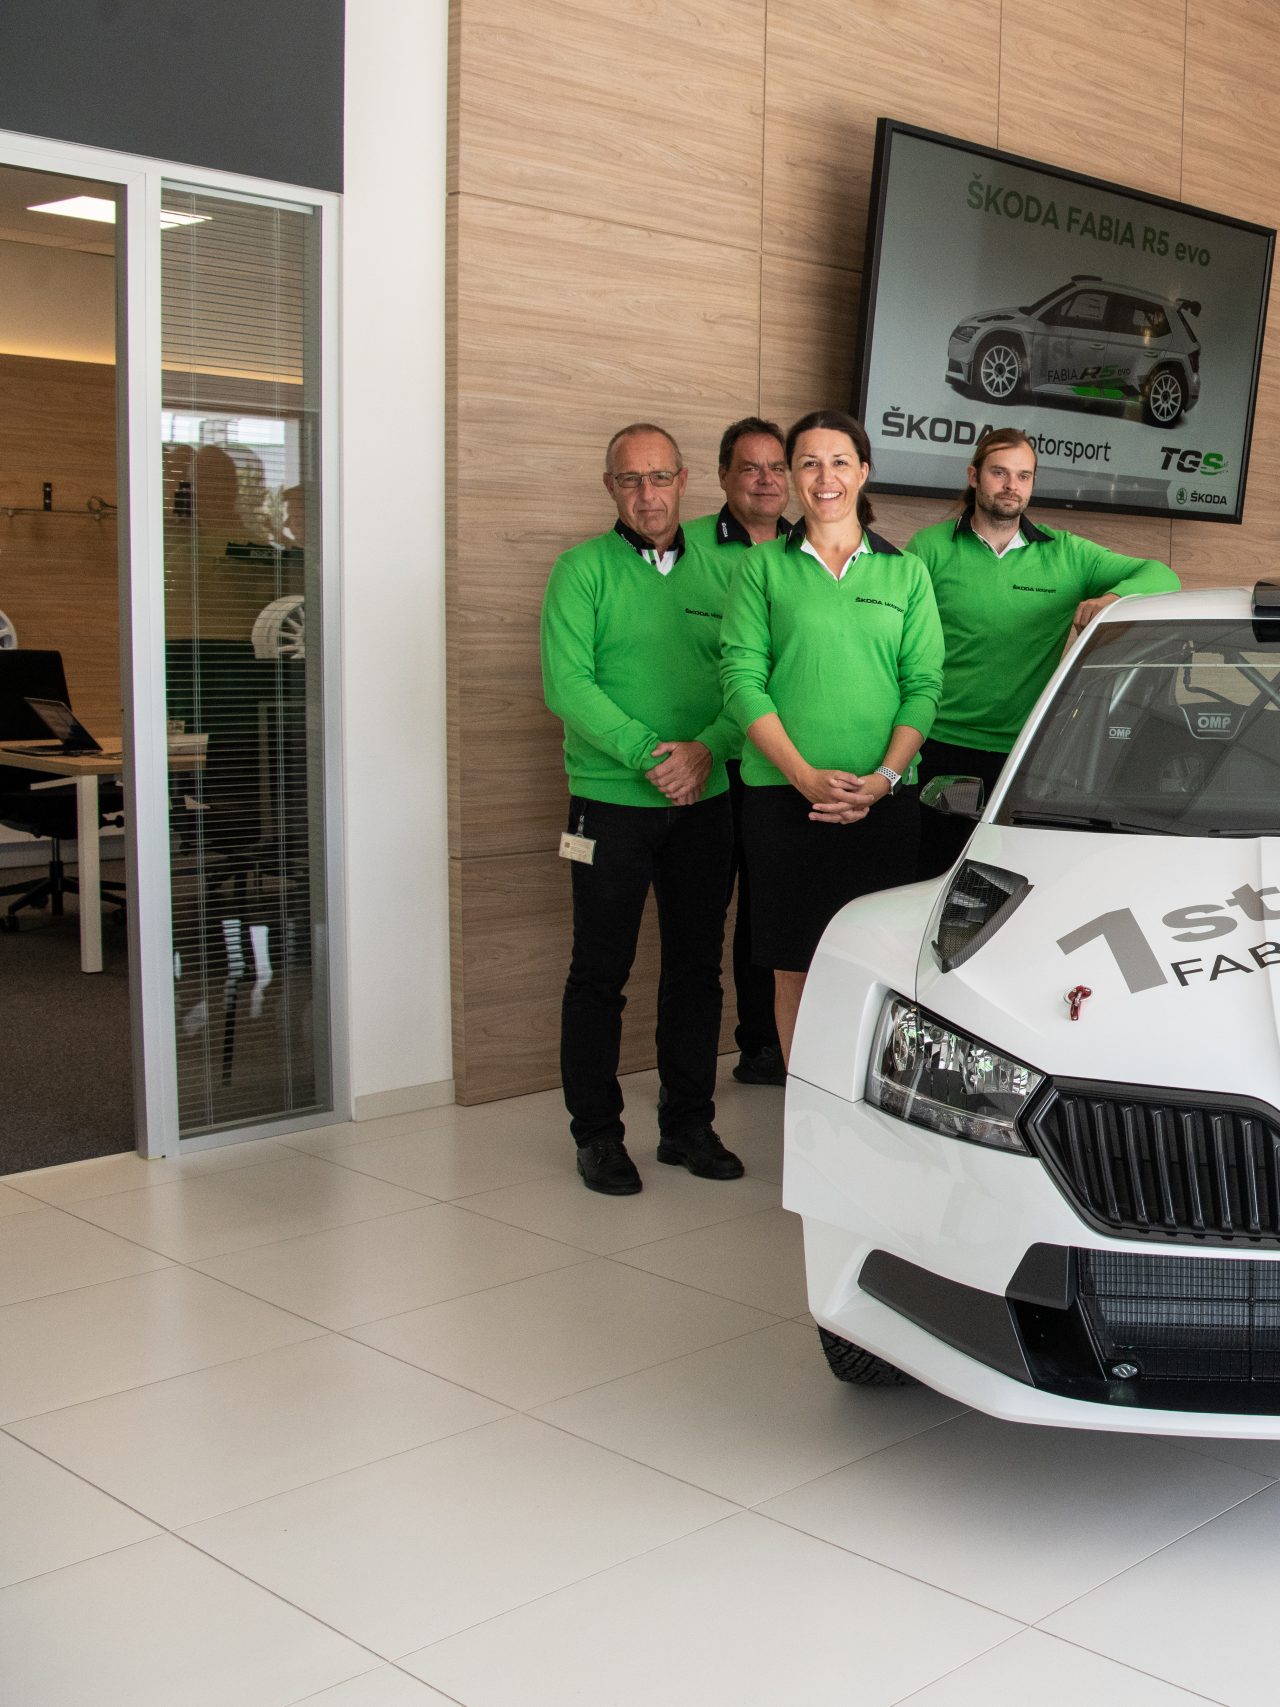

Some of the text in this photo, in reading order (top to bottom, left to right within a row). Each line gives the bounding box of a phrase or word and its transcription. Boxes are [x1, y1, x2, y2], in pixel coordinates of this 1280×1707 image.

[966, 172, 1211, 267] ŠKODA FABIA R5 evo
[1047, 368, 1078, 382] FABIA
[1079, 364, 1119, 380] R5
[881, 405, 1112, 464] ŠKODA otorsport
[1160, 446, 1226, 476] TGS
[1189, 490, 1228, 505] ŠKODA
[1197, 715, 1231, 730] OMP
[1108, 727, 1132, 738] OMP
